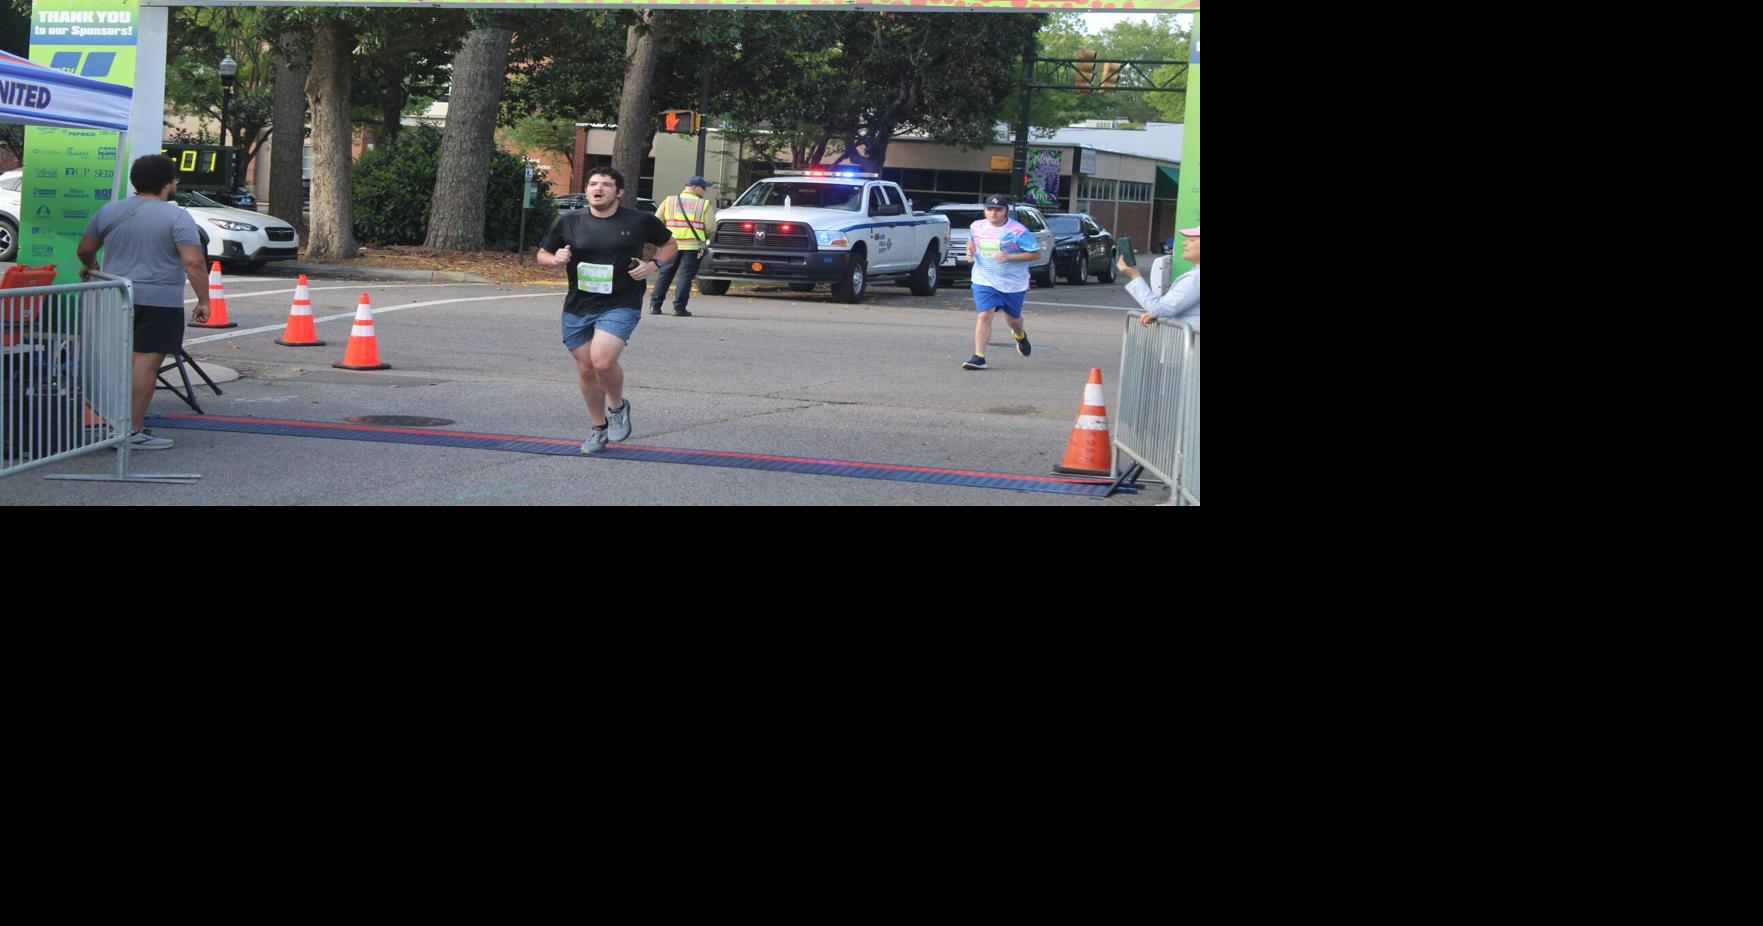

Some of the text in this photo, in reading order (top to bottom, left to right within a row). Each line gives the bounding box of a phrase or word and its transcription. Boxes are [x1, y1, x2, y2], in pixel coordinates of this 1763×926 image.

[38, 11, 131, 23] THANK YOU
[35, 25, 133, 37] to our Sponsors!
